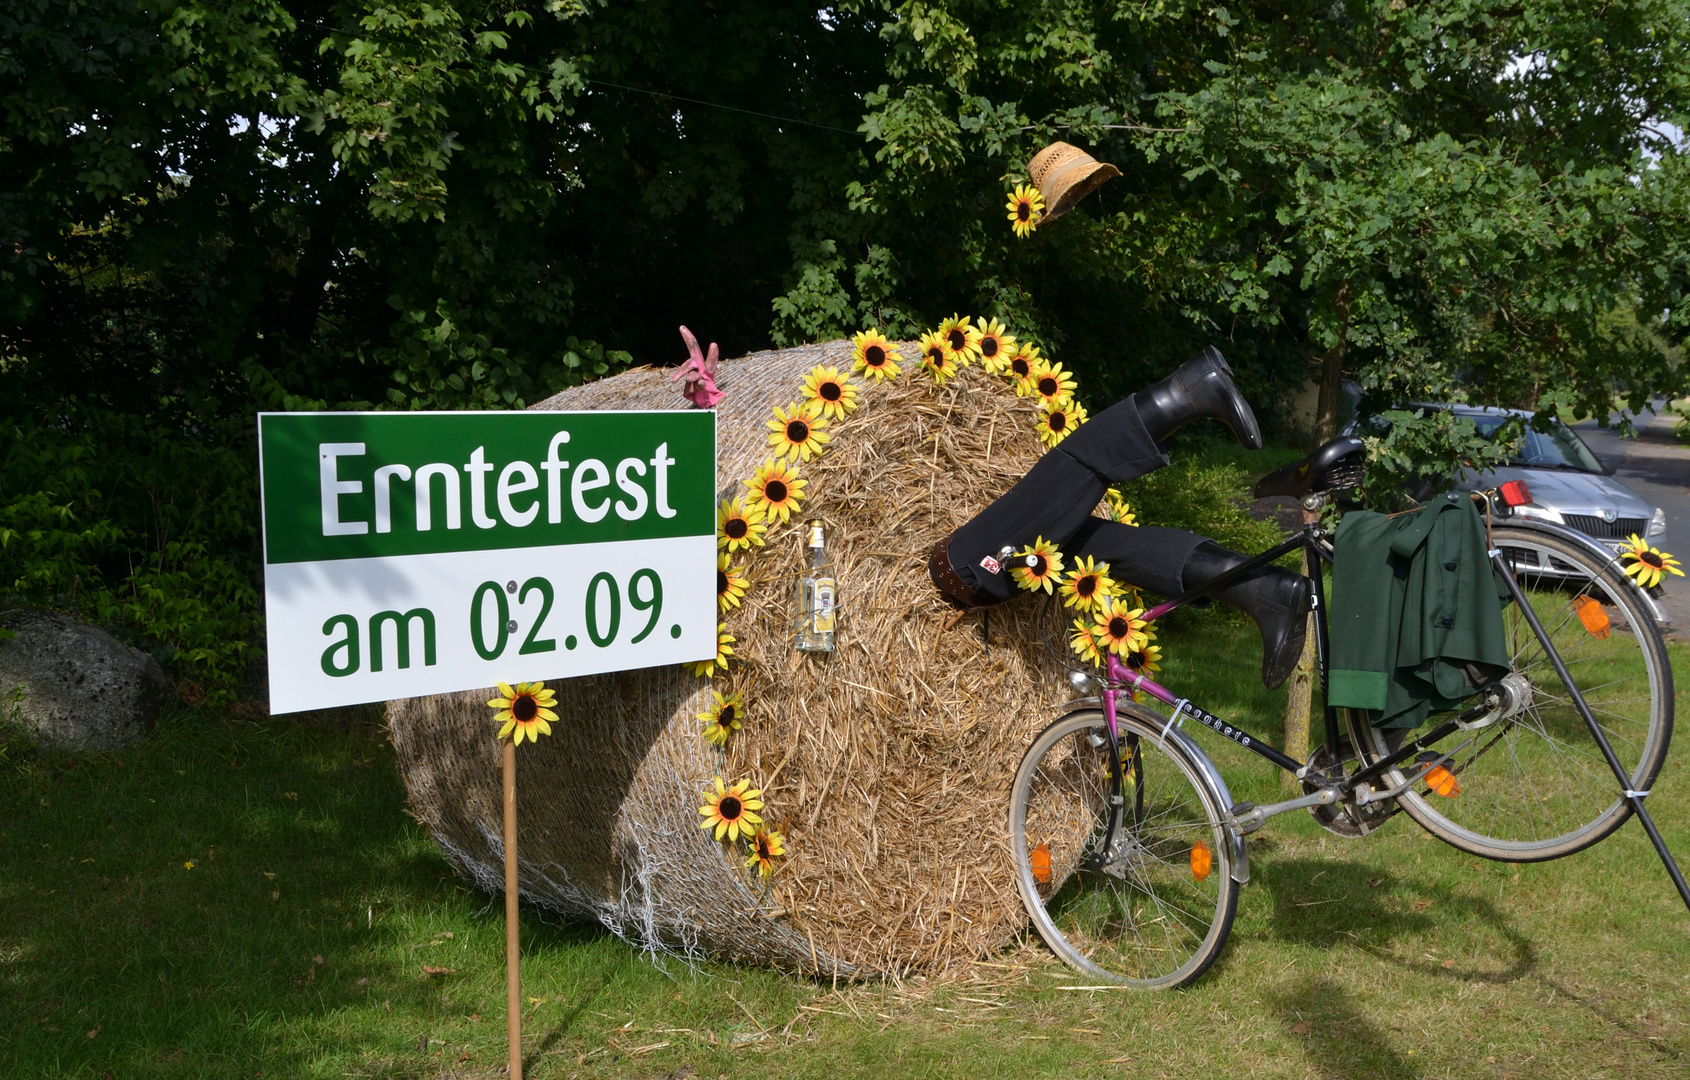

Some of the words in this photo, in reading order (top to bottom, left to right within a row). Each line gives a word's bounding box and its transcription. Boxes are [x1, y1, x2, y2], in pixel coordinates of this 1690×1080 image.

[319, 430, 677, 537] Erntefest
[320, 607, 437, 678] am
[469, 567, 683, 661] 02.09.
